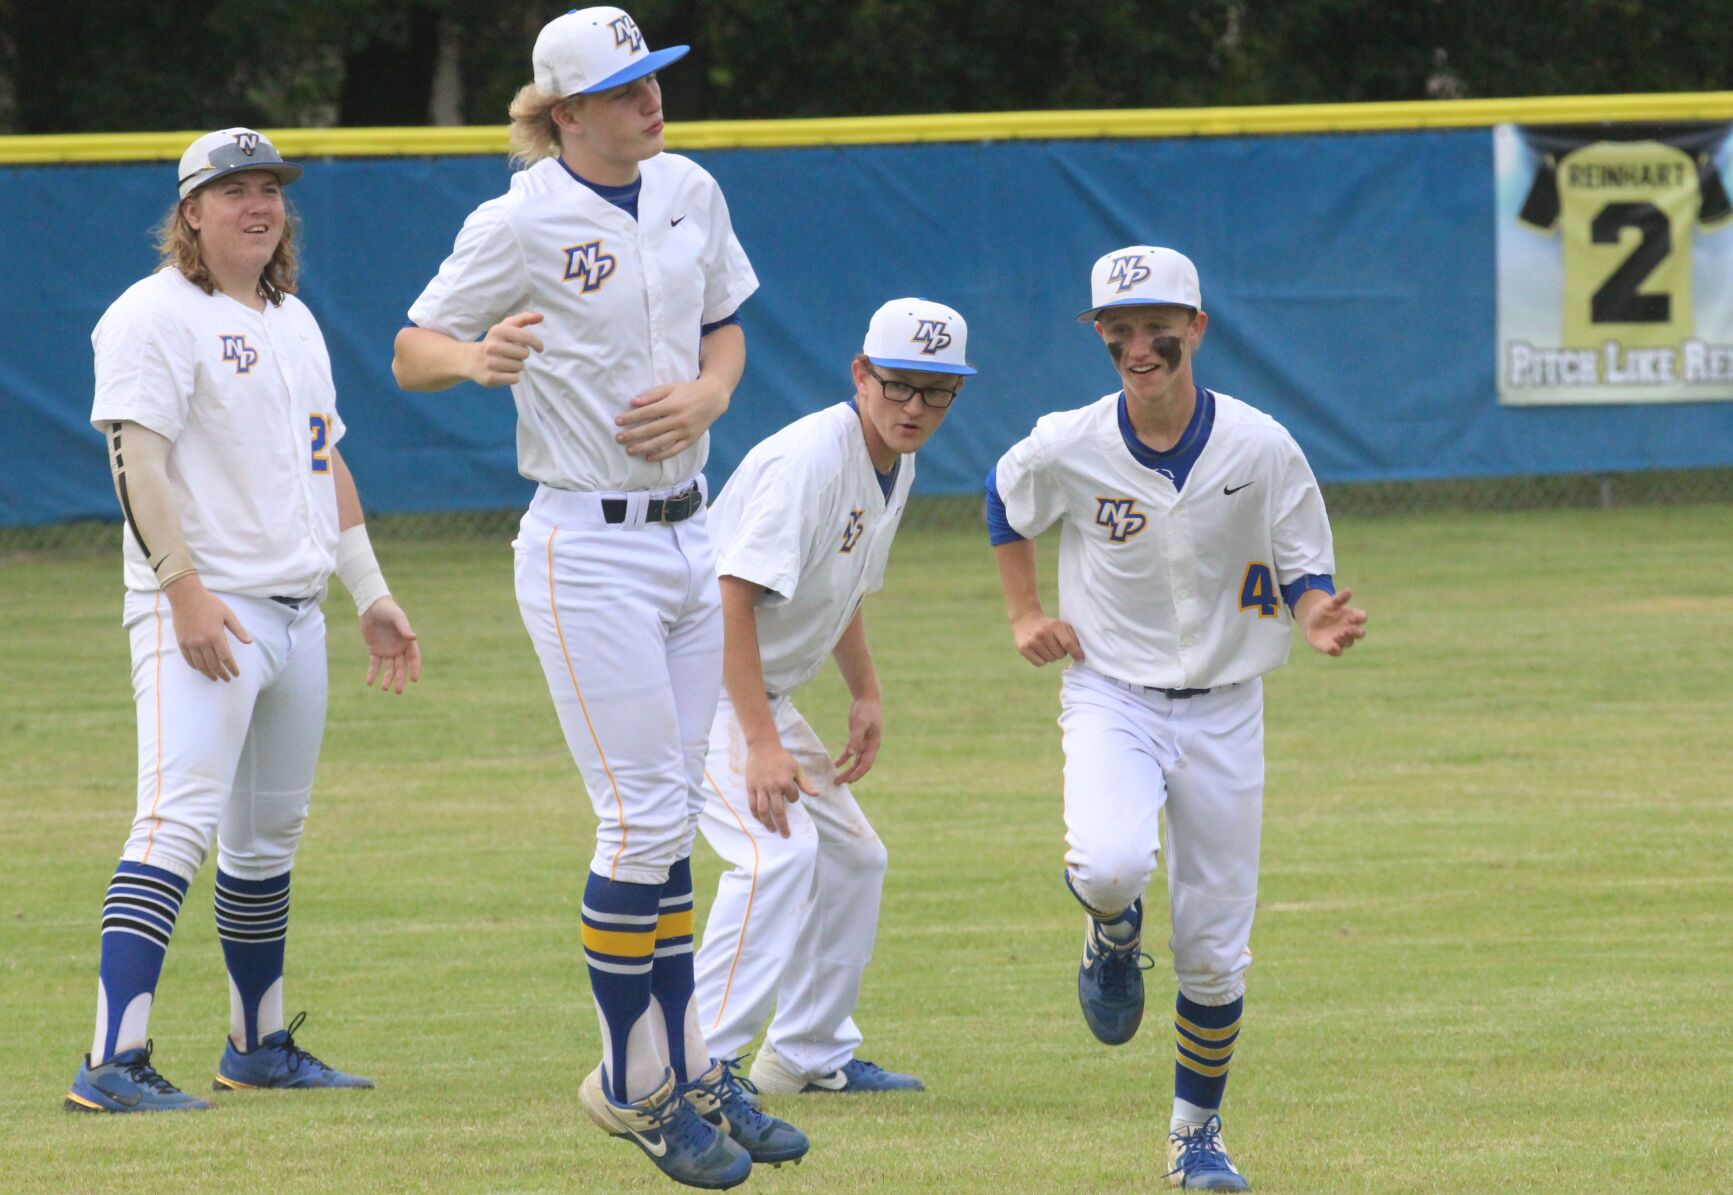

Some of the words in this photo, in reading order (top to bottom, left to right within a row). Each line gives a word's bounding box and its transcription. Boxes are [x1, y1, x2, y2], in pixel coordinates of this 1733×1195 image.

[1569, 162, 1684, 187] REINHART
[561, 239, 618, 295] NP
[1106, 255, 1152, 294] NP
[1591, 202, 1671, 323] 2
[219, 334, 258, 374] NP
[911, 319, 952, 355] NP
[309, 412, 332, 474] 2
[1095, 496, 1148, 544] NP
[1238, 561, 1280, 618] 4
